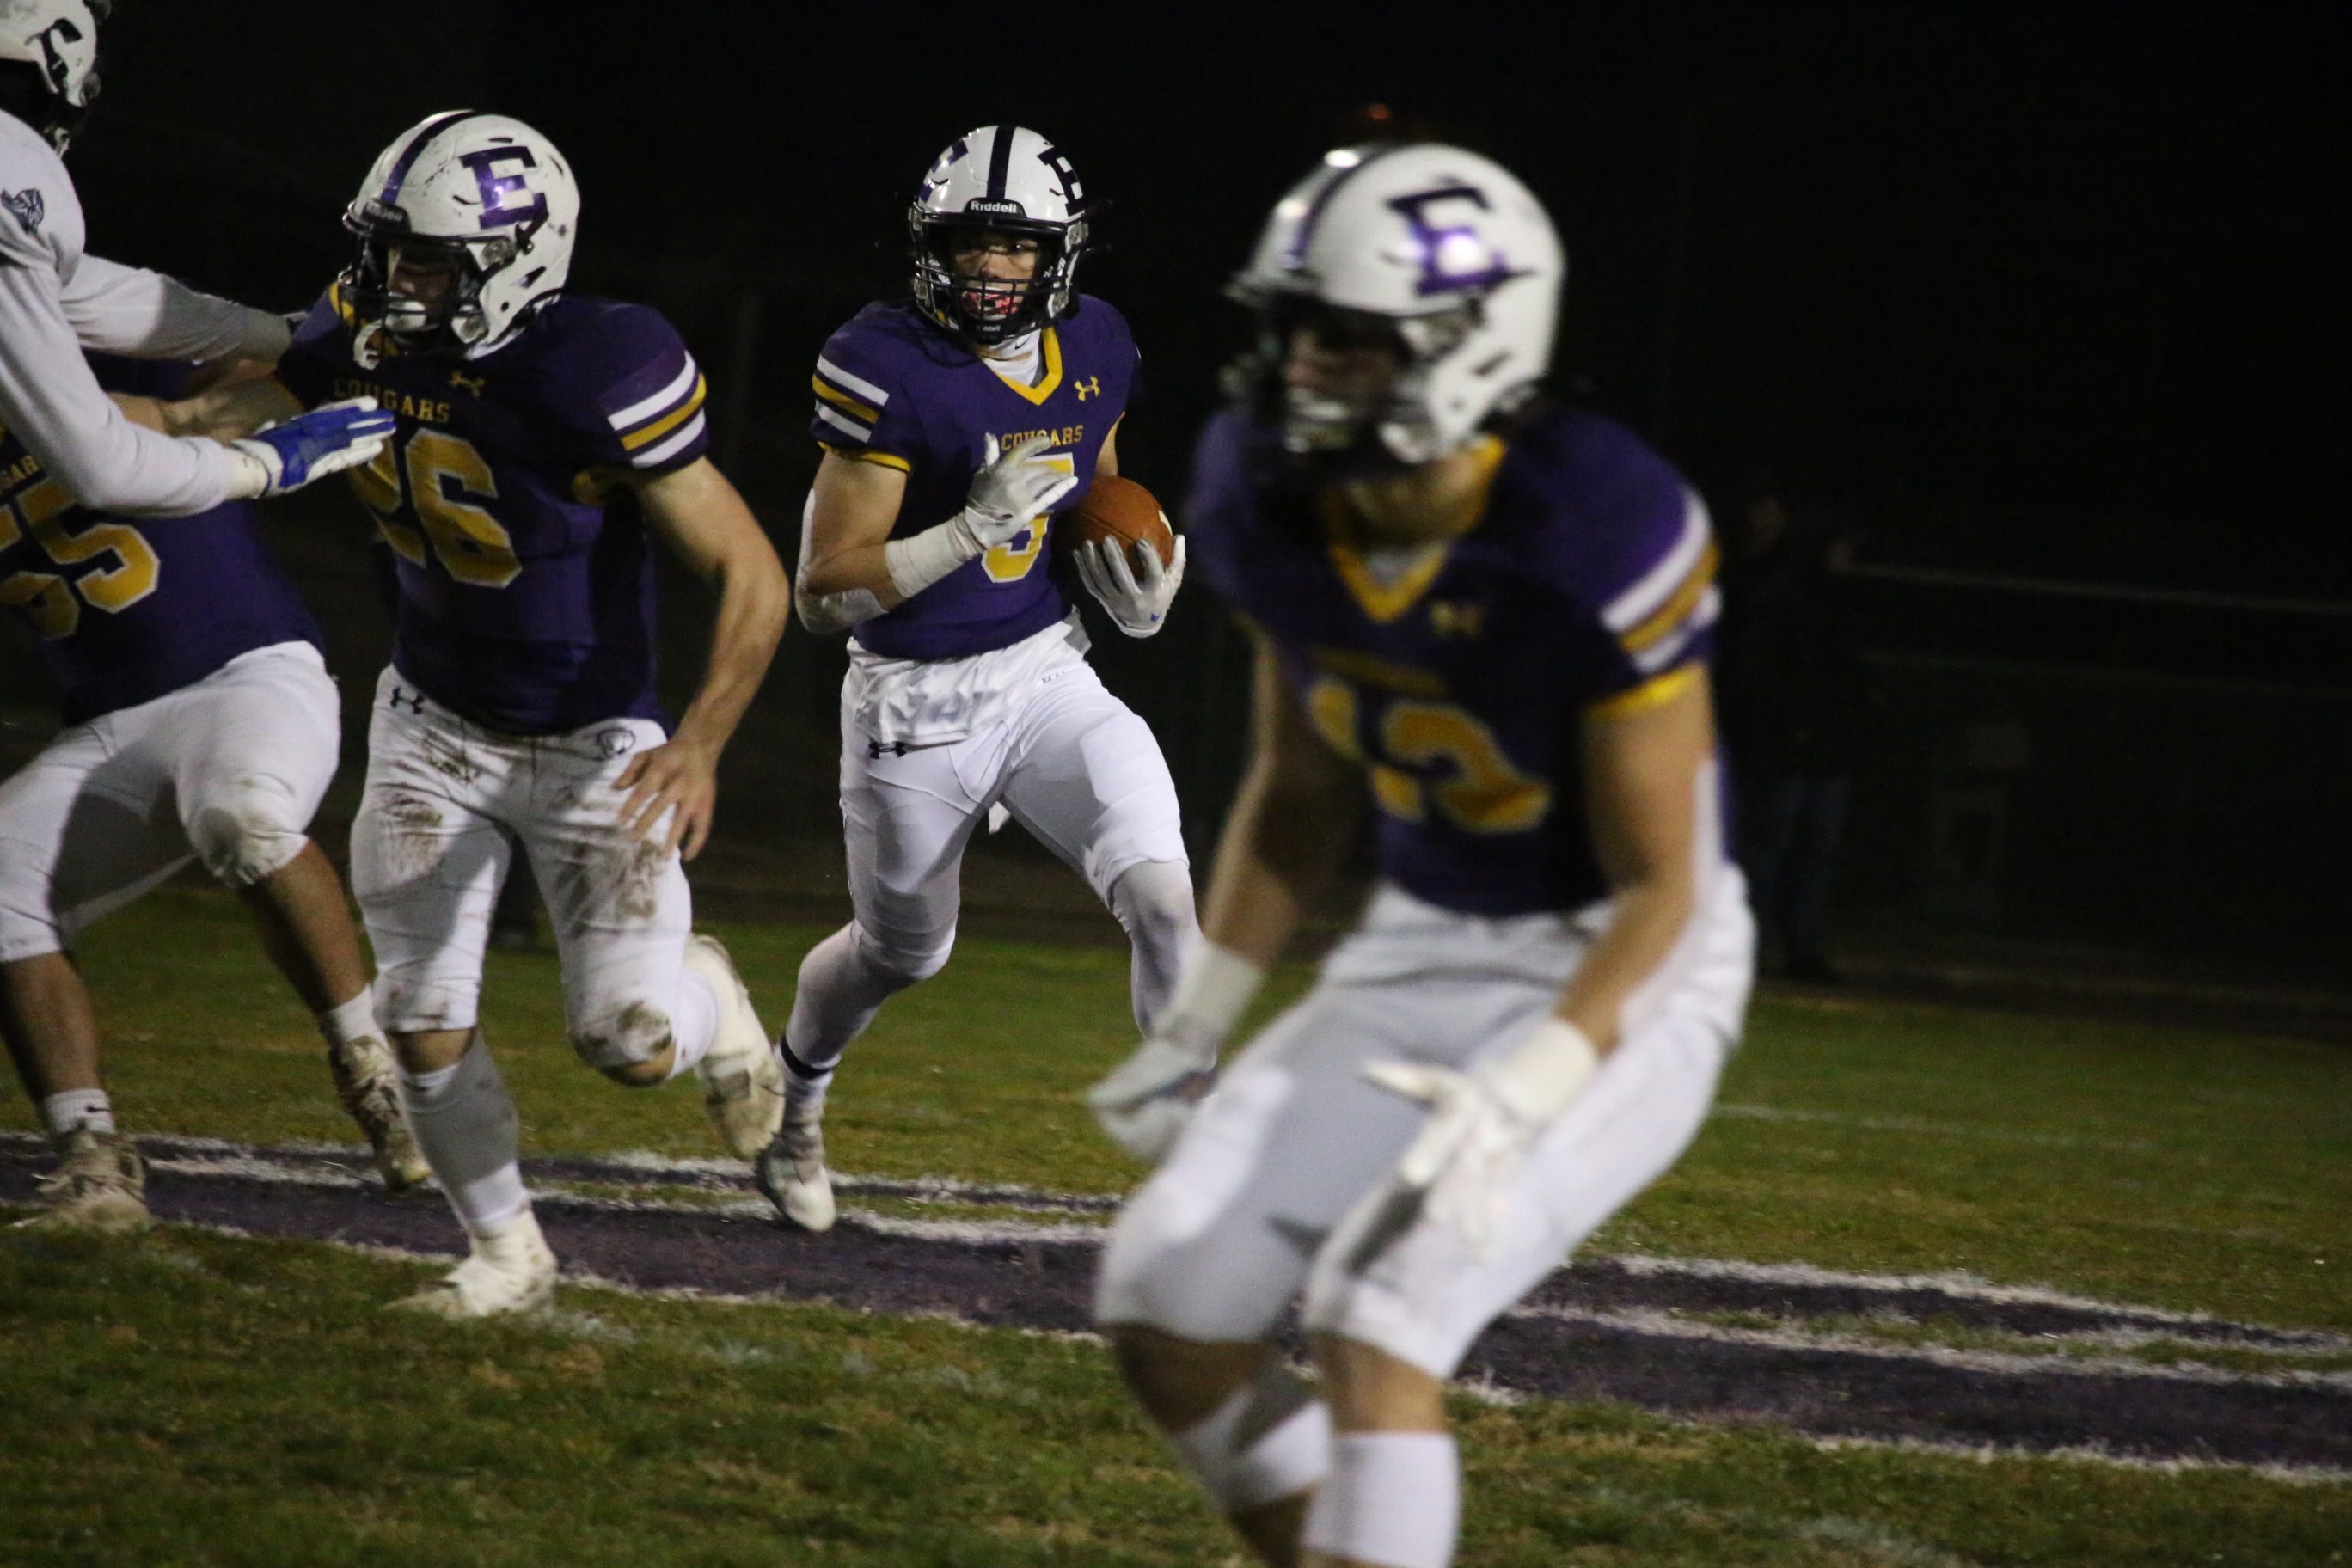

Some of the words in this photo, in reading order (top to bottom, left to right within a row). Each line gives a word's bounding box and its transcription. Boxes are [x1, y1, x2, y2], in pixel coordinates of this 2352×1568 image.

[458, 145, 550, 230] E
[970, 200, 1017, 214] Riddell
[1036, 146, 1085, 217] E
[1386, 186, 1510, 297] E
